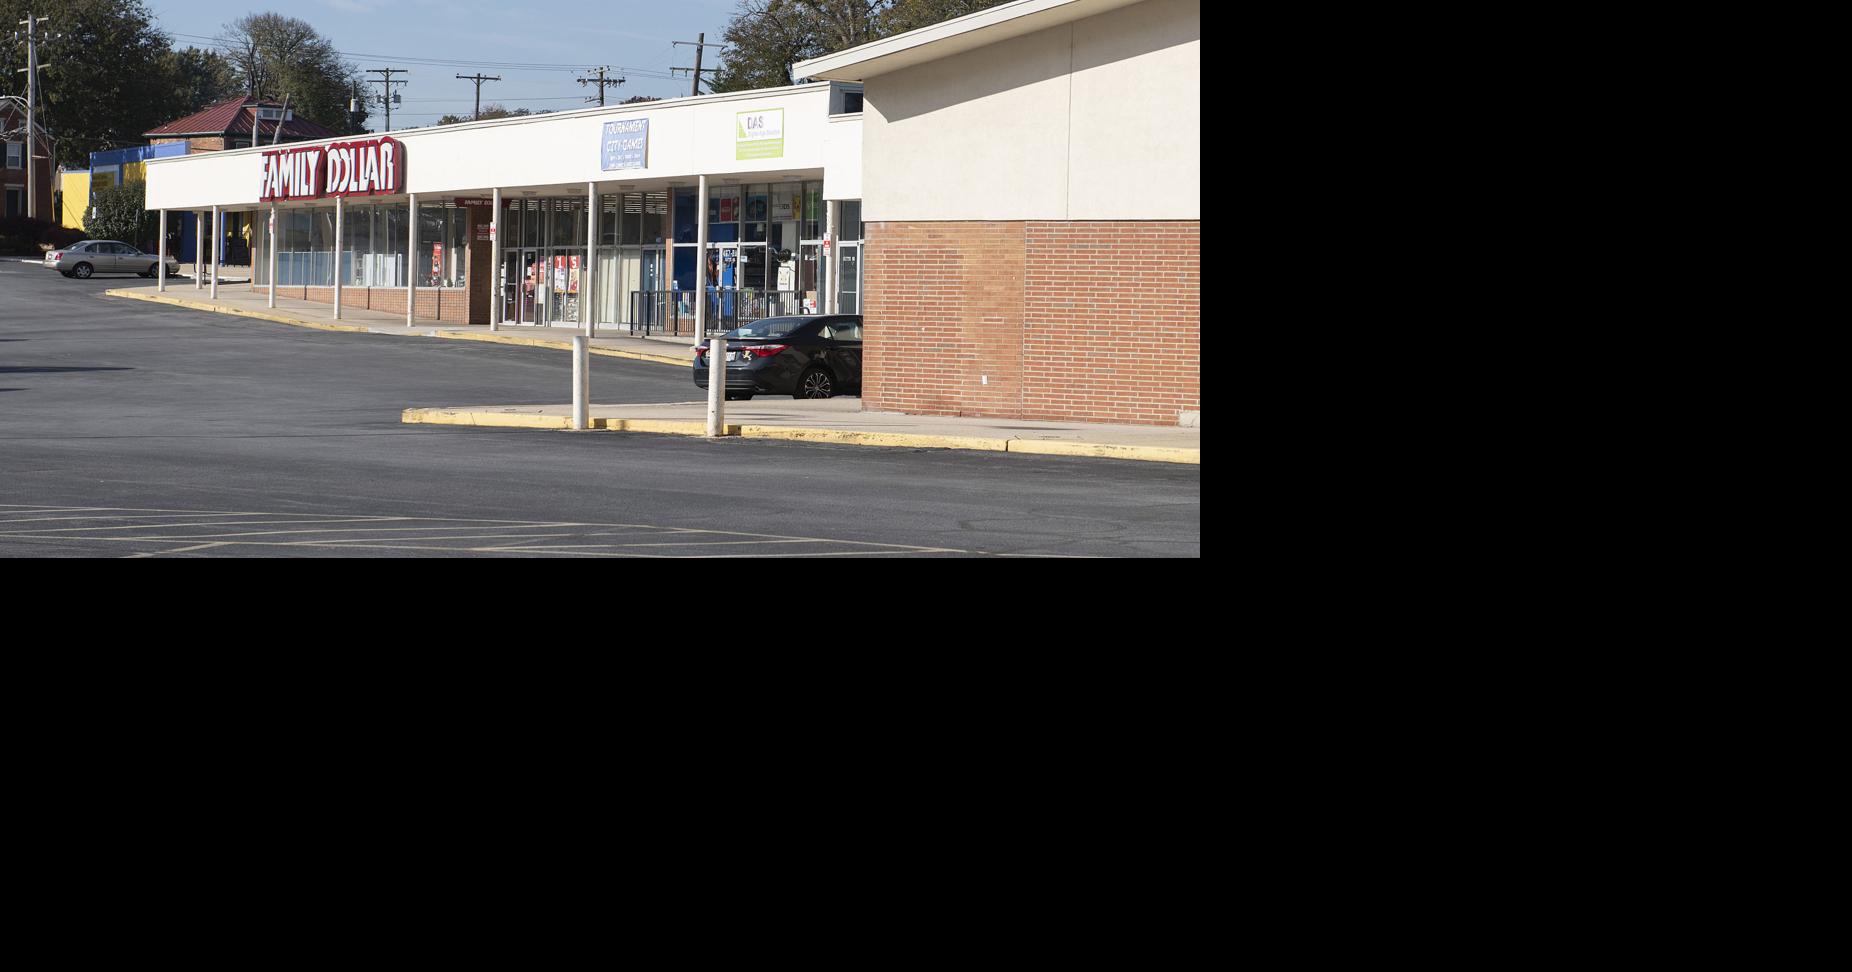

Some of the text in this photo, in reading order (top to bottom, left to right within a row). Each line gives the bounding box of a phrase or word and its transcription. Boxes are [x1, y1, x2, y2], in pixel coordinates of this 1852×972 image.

[747, 116, 764, 129] DAS
[607, 140, 622, 152] CITY
[259, 142, 394, 198] FAMILY DOLLAR
